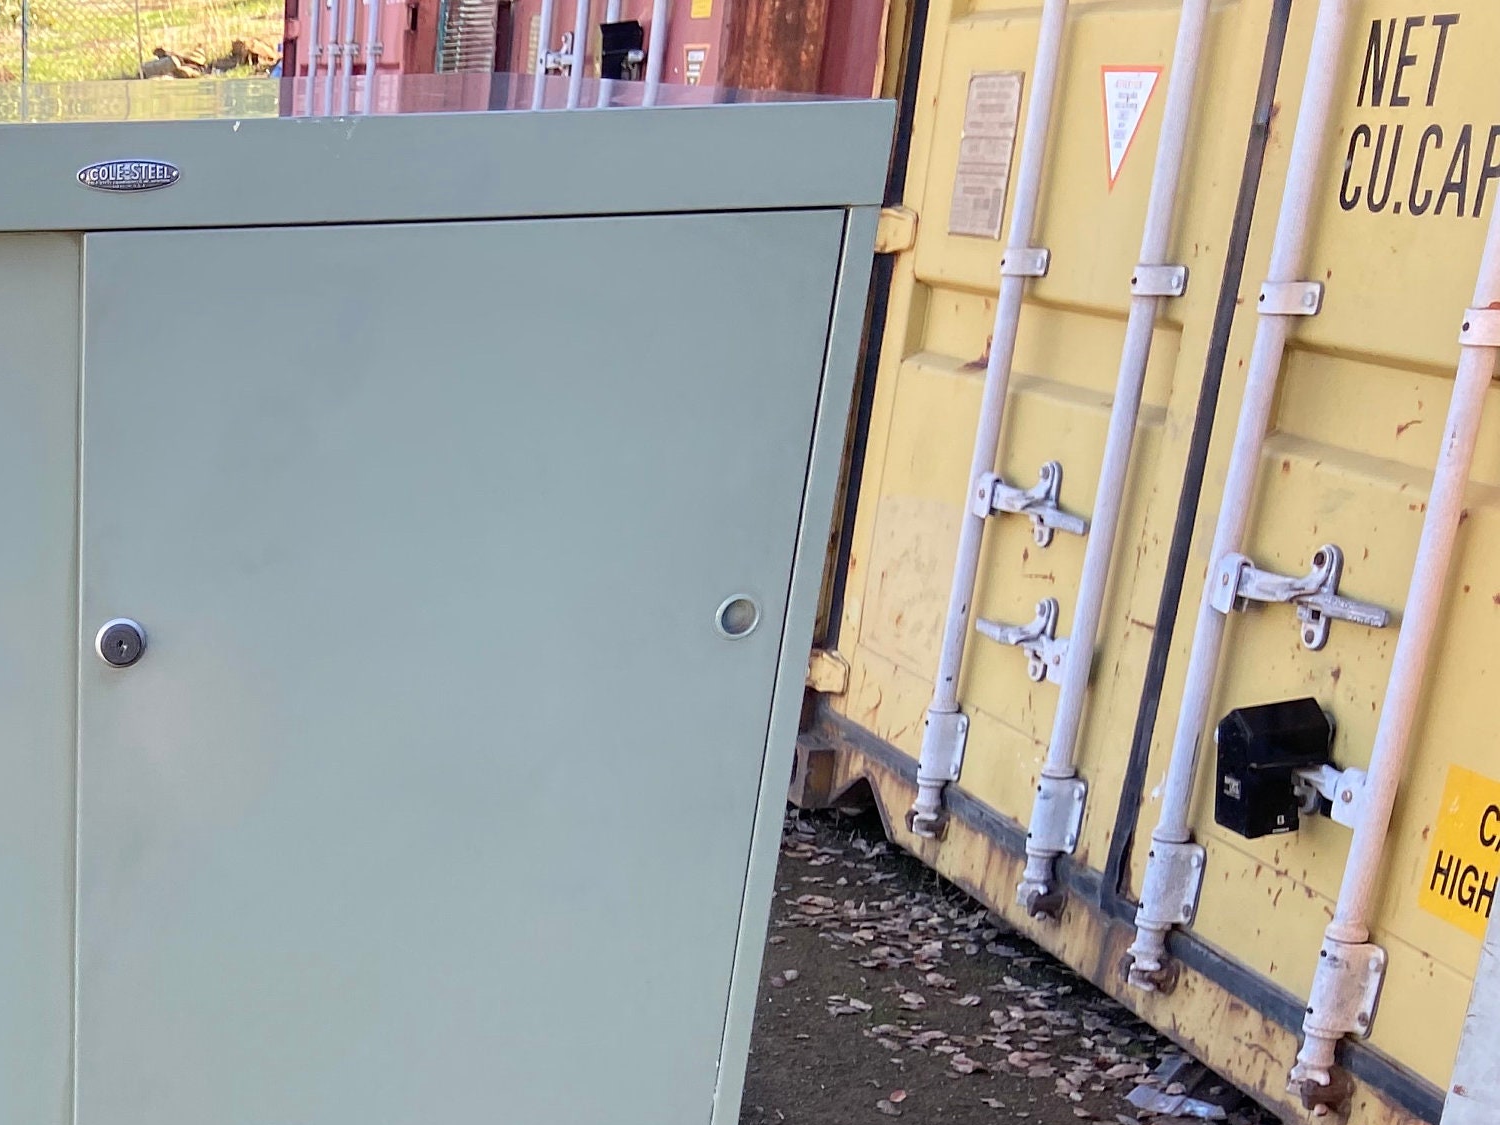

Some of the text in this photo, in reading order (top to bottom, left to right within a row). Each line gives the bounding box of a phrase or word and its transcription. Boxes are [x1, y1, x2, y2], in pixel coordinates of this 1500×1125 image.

[1356, 13, 1461, 108] NET
[1479, 804, 1500, 852] C
[1430, 849, 1498, 918] HIGH
